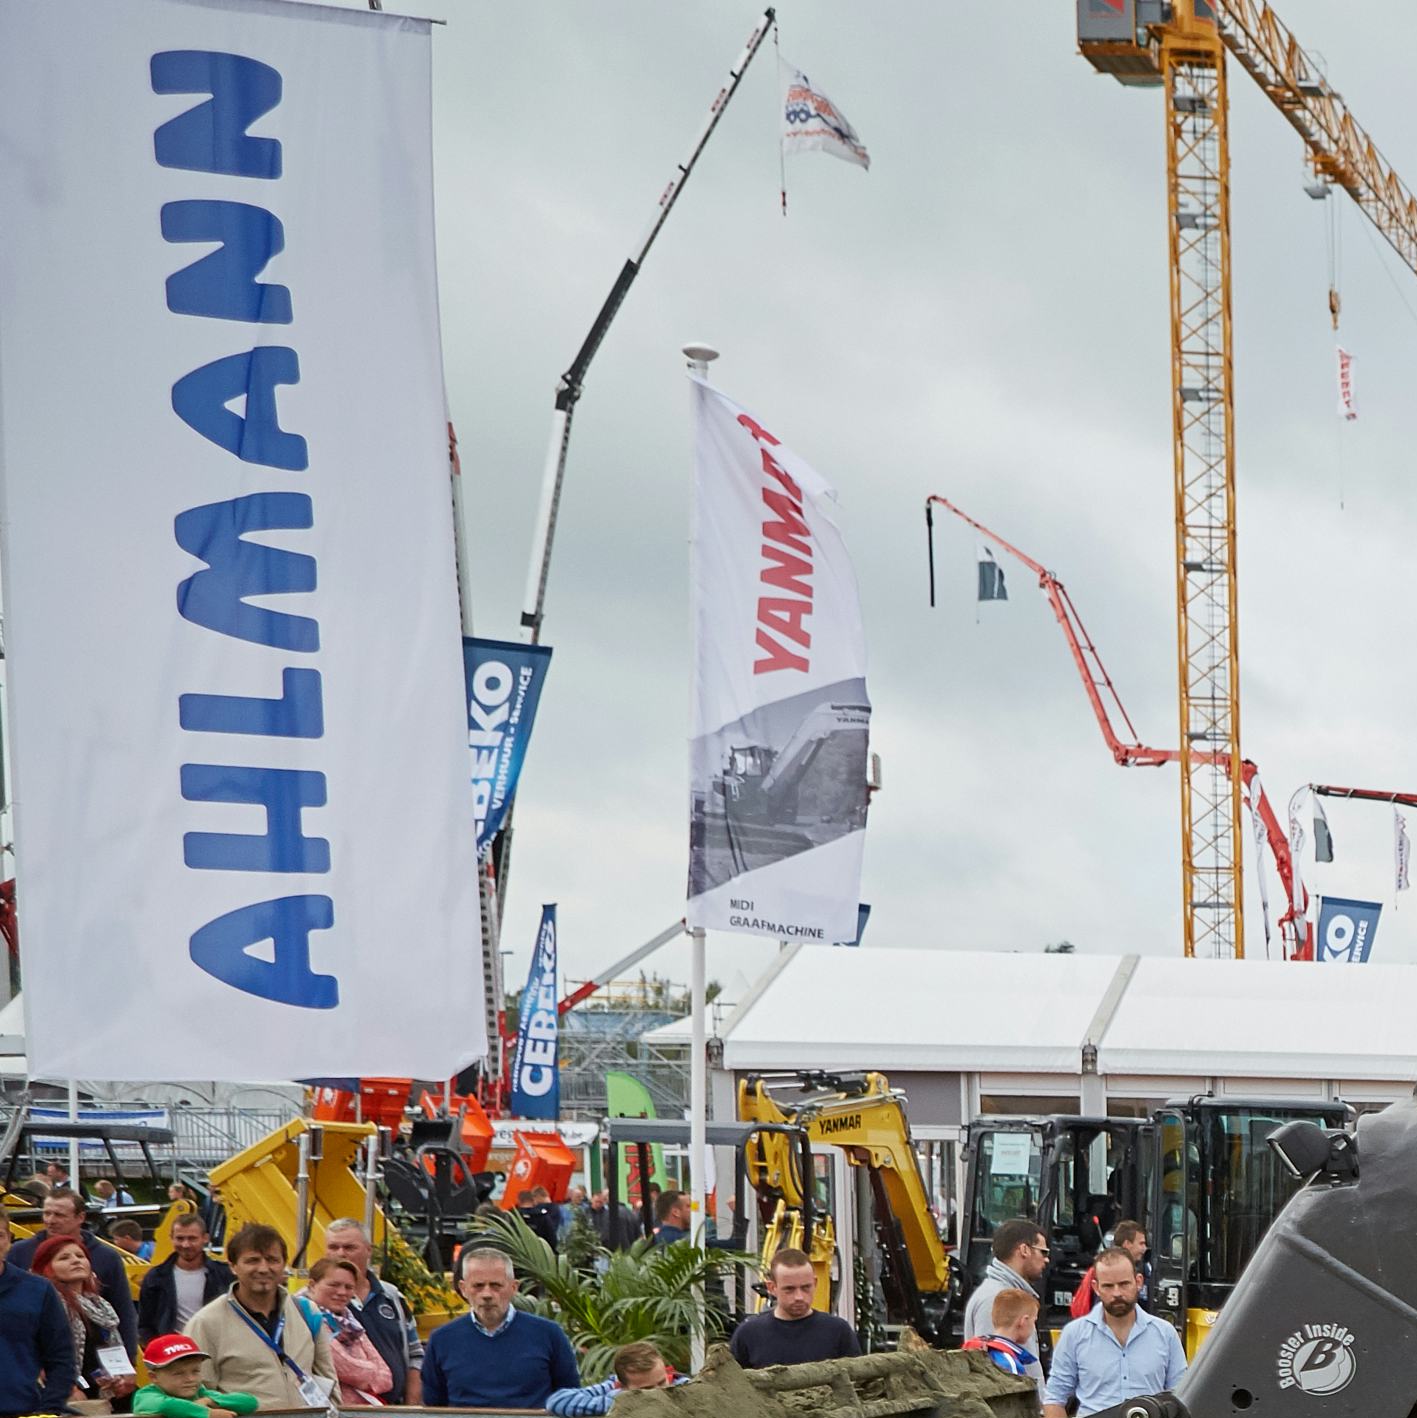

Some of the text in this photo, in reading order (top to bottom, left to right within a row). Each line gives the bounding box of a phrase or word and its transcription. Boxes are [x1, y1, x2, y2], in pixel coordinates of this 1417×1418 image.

[150, 50, 339, 1010] AHLMANN
[729, 898, 755, 912] MIDI
[729, 915, 825, 939] GRAAFMACHINE
[1352, 919, 1369, 962] ERVICE
[819, 1114, 862, 1135] YANMAR
[1278, 1322, 1356, 1390] Booster Inside
